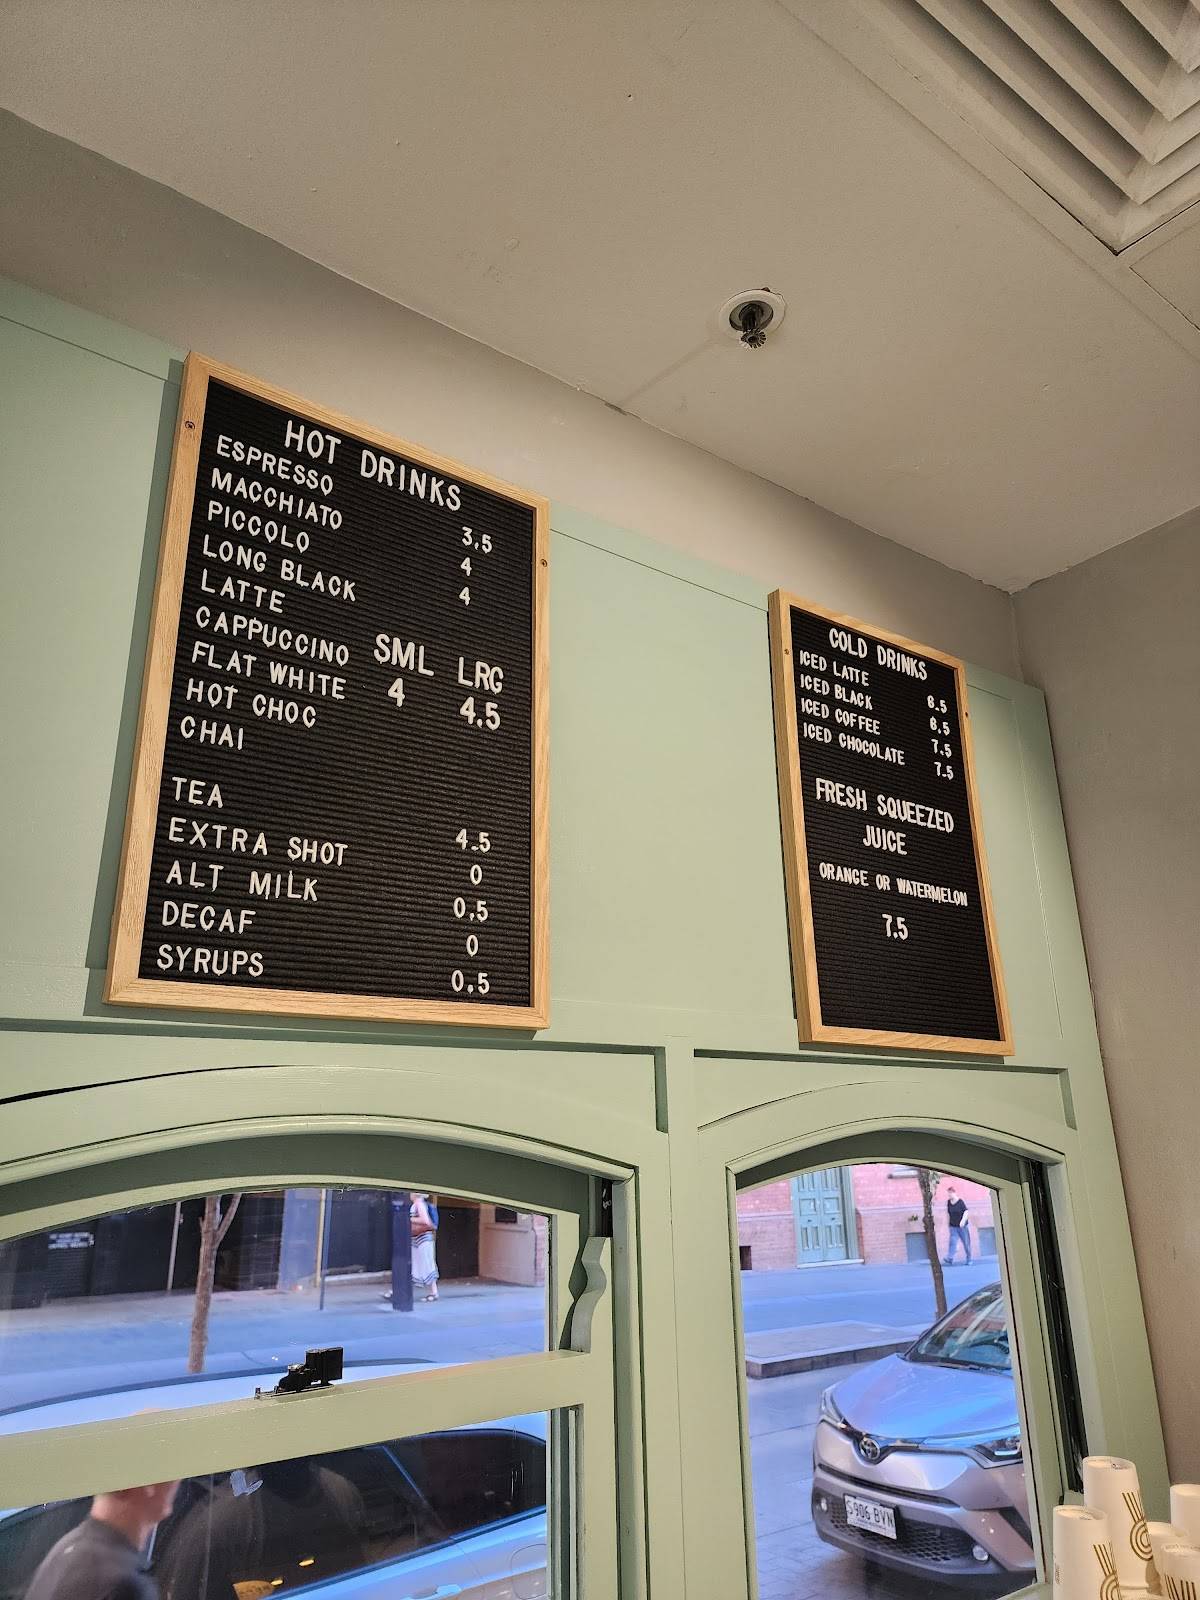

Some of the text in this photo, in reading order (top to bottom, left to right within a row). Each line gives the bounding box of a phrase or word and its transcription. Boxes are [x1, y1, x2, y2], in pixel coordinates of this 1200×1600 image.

[217, 435, 333, 496] ESPRESSO
[285, 420, 461, 511] HOT DRINKS
[212, 468, 472, 576] MACCHIATO 4
[203, 535, 355, 601] LONG BLACK
[208, 501, 470, 606] PICCOLO 4
[202, 569, 285, 613] LATTE
[196, 606, 349, 666] CAPPUCCINO
[829, 628, 927, 680] COLD DRINKS
[192, 641, 346, 700] FLAT WHITE
[374, 634, 503, 694] SML LRG
[800, 650, 827, 671] ICED
[833, 661, 869, 686] LATTE
[186, 678, 316, 728] HOT CHOC
[388, 678, 405, 707] 4
[801, 674, 830, 695] ICED
[835, 684, 872, 710] BLACK
[181, 716, 243, 750] CHAI
[802, 698, 951, 758] ICED COFFEE 7.5
[804, 723, 832, 743] ICED
[839, 733, 905, 765] CHOCOLATE
[172, 777, 223, 808] TEA
[816, 778, 954, 833] FRESH SQUEEZED
[169, 817, 482, 885] EXTRA SHOT 0
[863, 825, 907, 855] JUICE
[166, 861, 224, 892] ALT
[249, 870, 317, 901] MILK
[819, 862, 967, 906] ORANGE OR WATERMELON
[162, 901, 478, 957] DECAF 0
[882, 914, 908, 940] 7.5
[157, 944, 489, 994] SYRUPS 0.5
